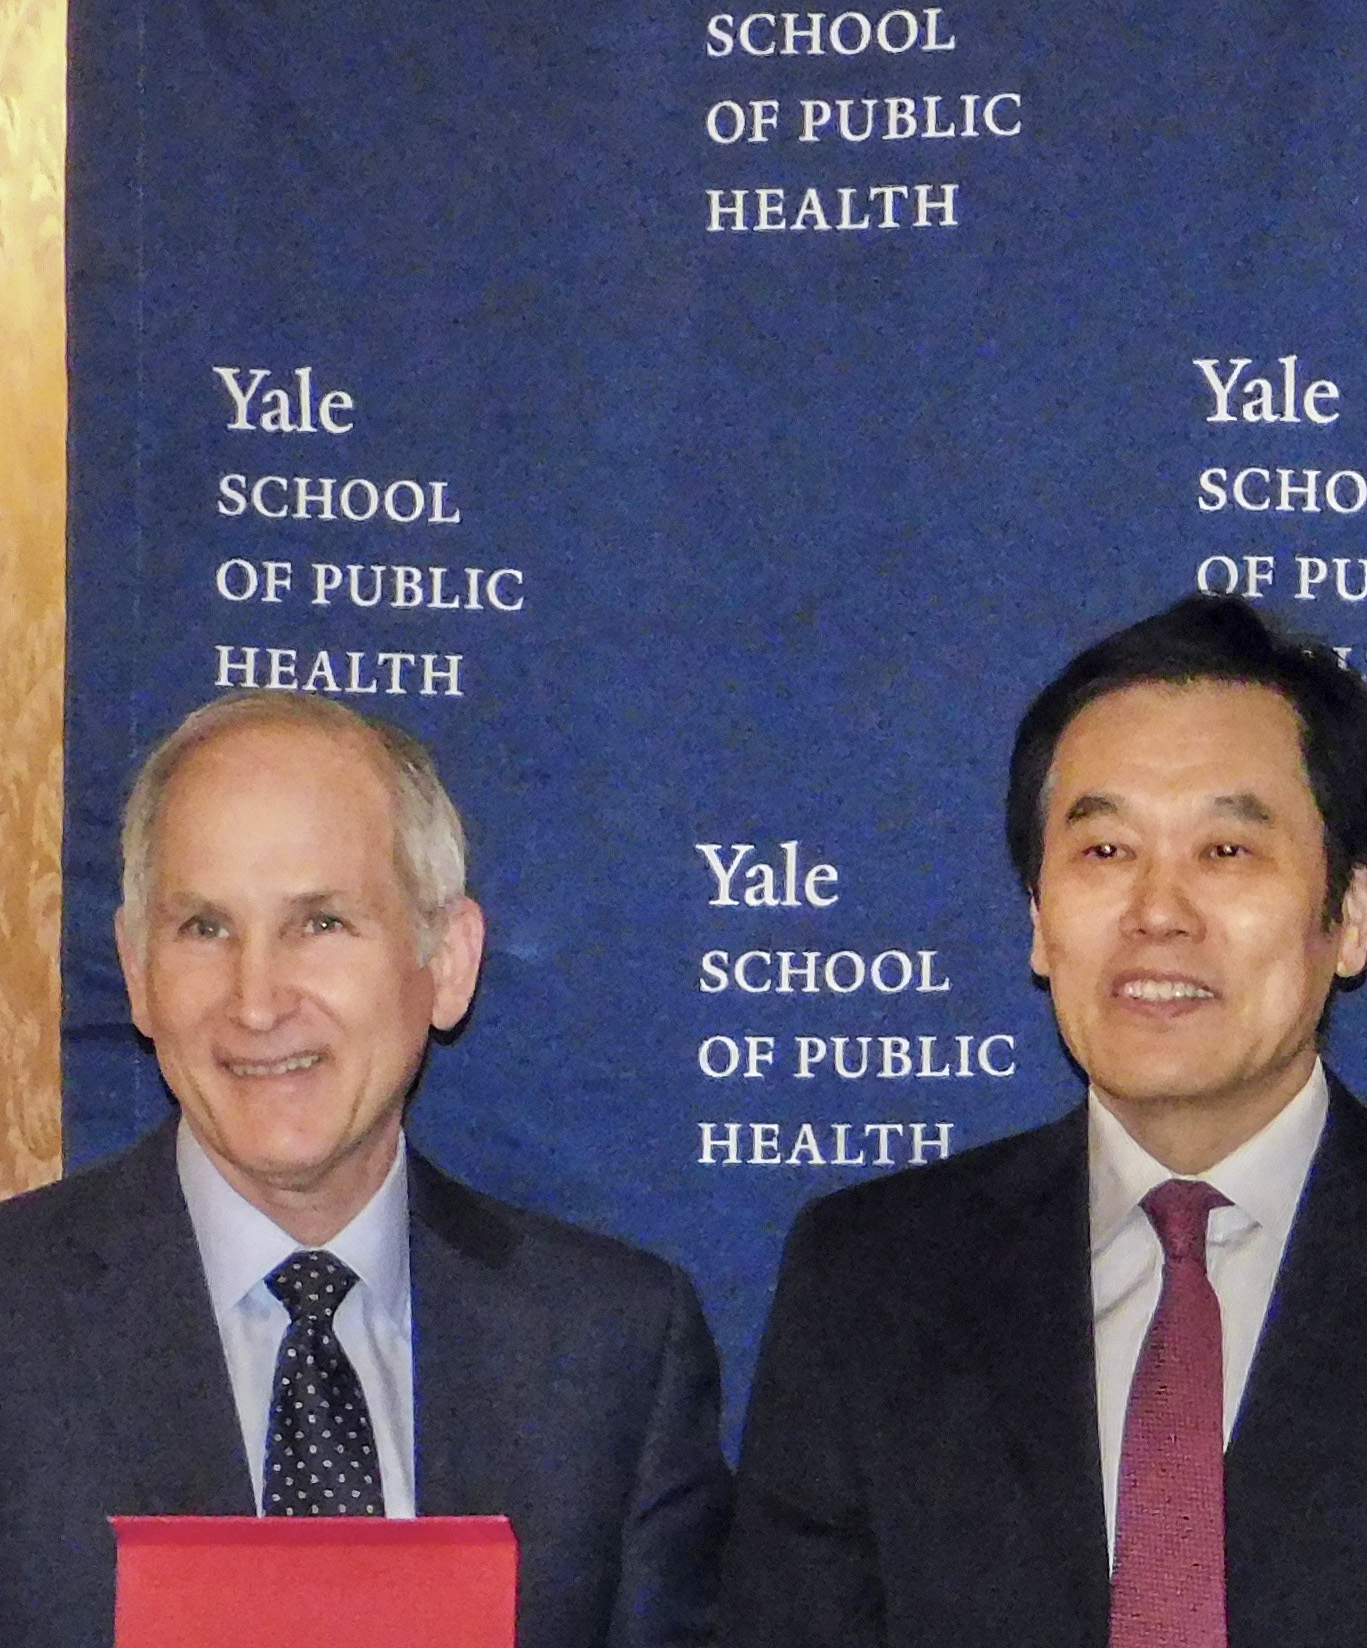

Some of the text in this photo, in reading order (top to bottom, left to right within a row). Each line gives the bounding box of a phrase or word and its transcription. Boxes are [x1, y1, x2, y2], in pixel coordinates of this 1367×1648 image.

[705, 6, 957, 58] SCHOOL
[705, 91, 1023, 145] OF PUBLIC
[704, 182, 960, 233] HEALTH
[211, 365, 355, 435] Yale
[1191, 353, 1341, 426] Yale
[216, 472, 462, 525] SCHOOL
[215, 557, 525, 613] OF PUBLIC
[1196, 554, 1275, 599] OF
[213, 644, 465, 697] HEALTH
[693, 839, 840, 909] Yale
[698, 948, 951, 995] SCHOOL
[697, 1033, 1016, 1080] OF PUBLIC
[696, 1121, 955, 1166] HEALTH
